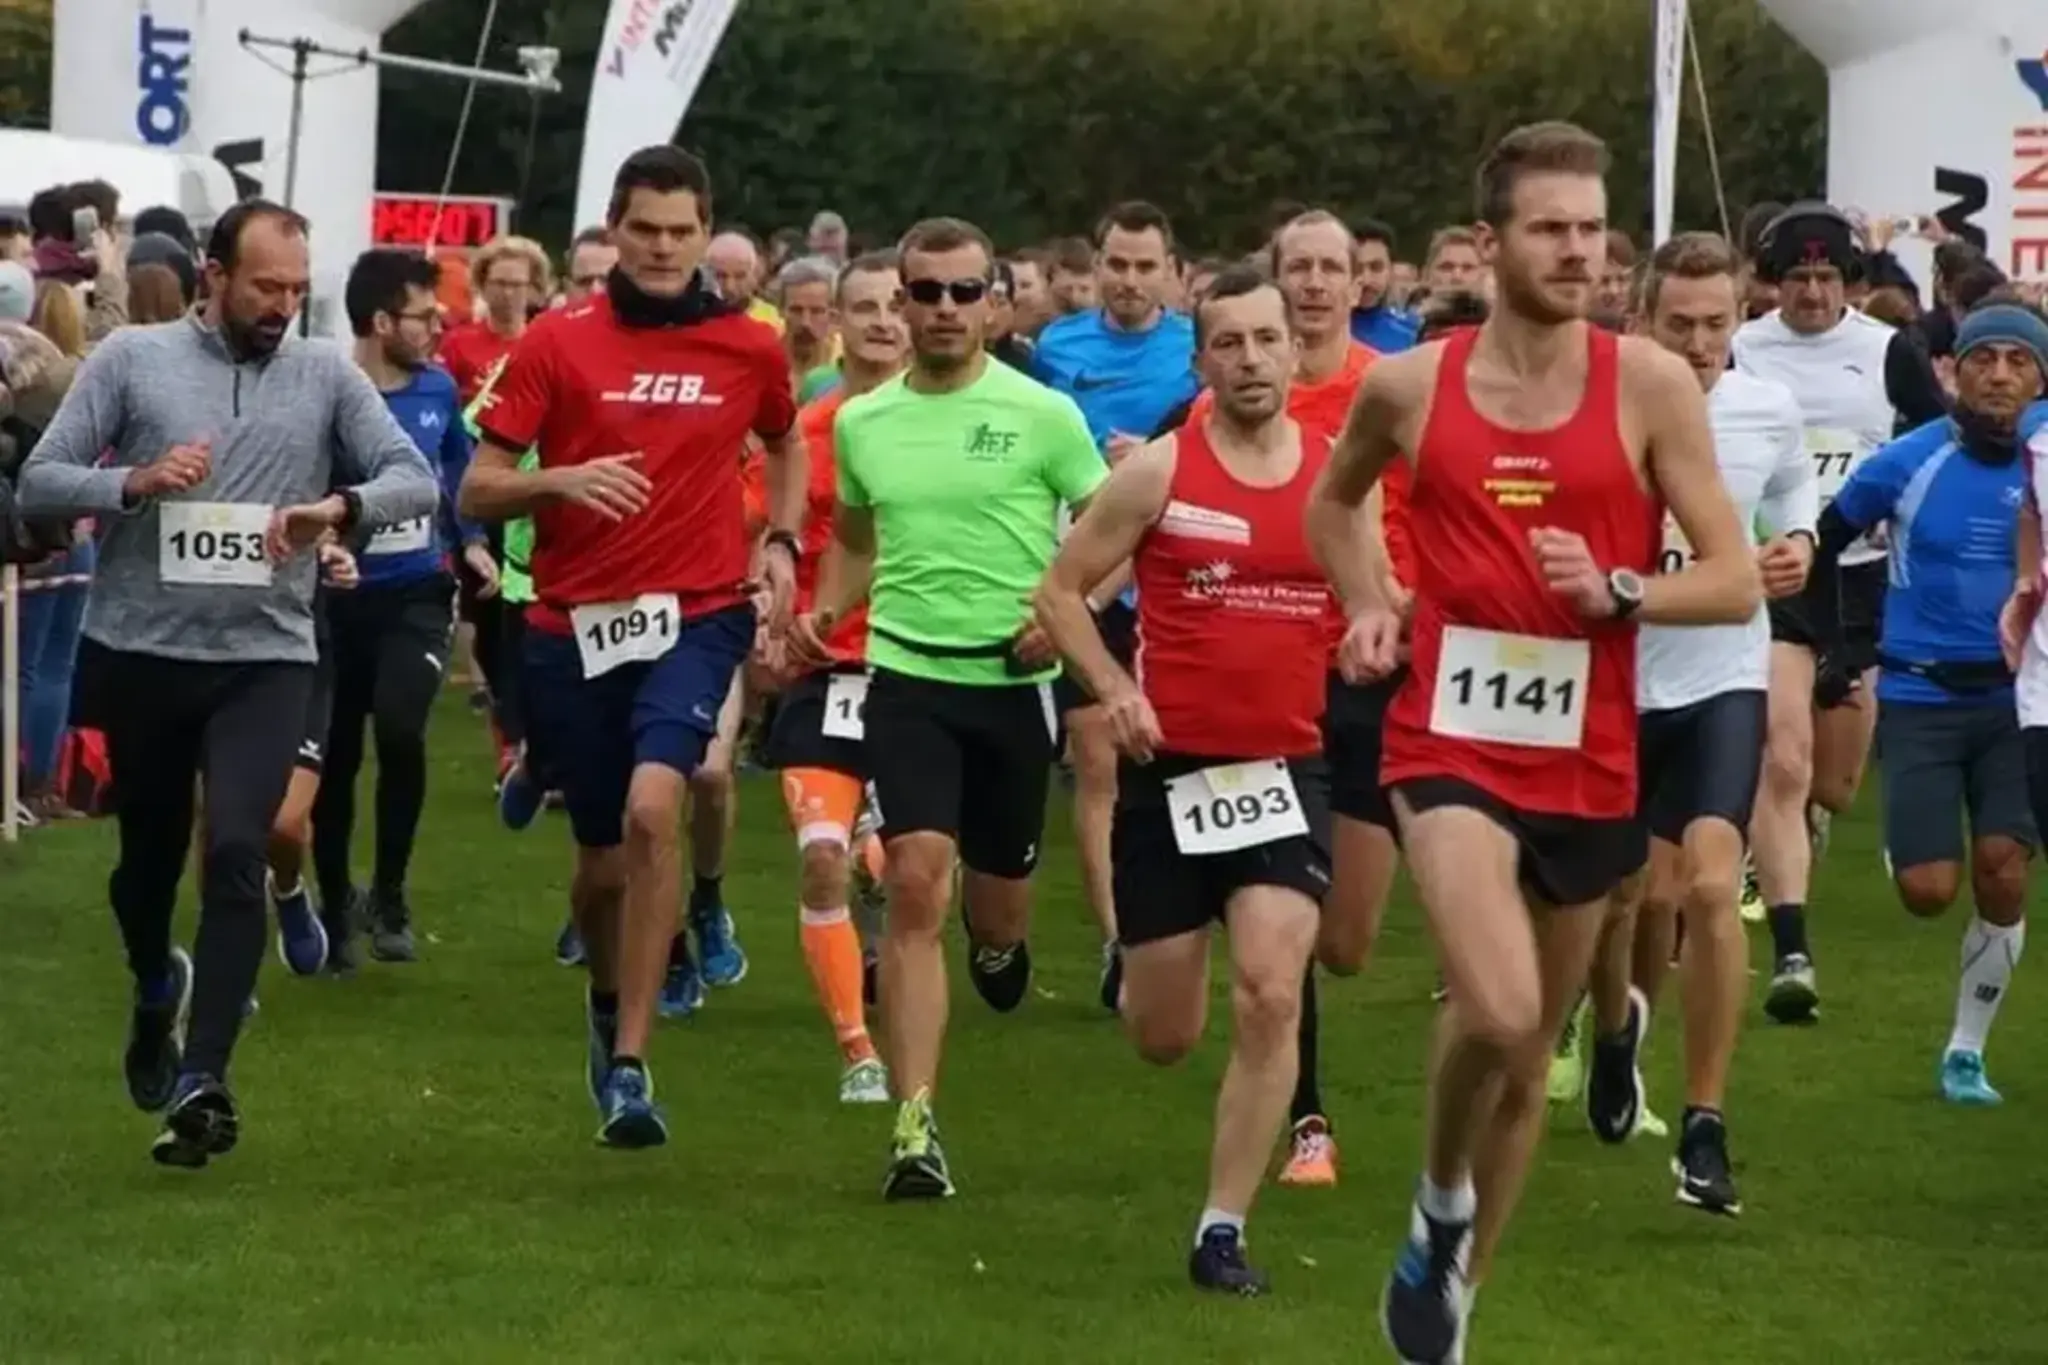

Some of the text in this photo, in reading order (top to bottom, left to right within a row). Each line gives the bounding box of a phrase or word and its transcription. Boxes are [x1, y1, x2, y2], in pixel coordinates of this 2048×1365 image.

[137, 14, 190, 146] ORT
[627, 374, 704, 404] ZGB
[169, 530, 264, 562] 1053
[586, 608, 669, 651] 1091
[1450, 667, 1575, 715] 1141
[1184, 786, 1291, 834] 1093
